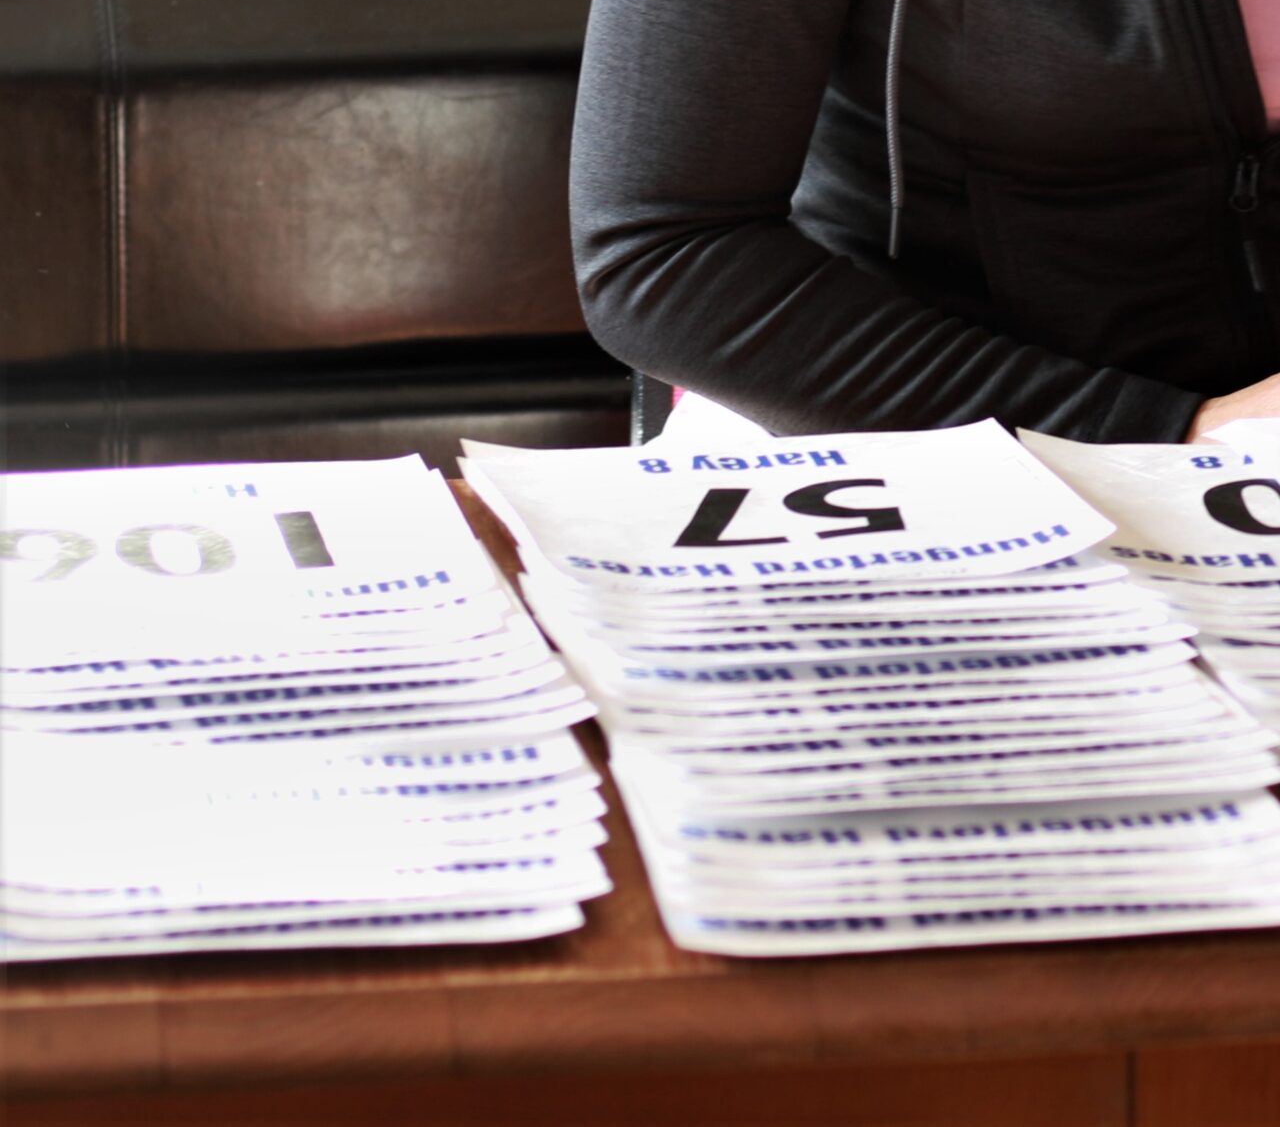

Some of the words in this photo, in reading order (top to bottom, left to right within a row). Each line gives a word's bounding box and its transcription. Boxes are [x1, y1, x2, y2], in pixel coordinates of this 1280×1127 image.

[638, 457, 672, 474] 8
[691, 449, 848, 471] Harey
[1189, 456, 1224, 469] 8
[672, 478, 906, 548] 57
[0, 510, 335, 582] 106
[752, 523, 1071, 576] Hungerford
[1109, 546, 1278, 568] Hares
[566, 555, 734, 577] Hares
